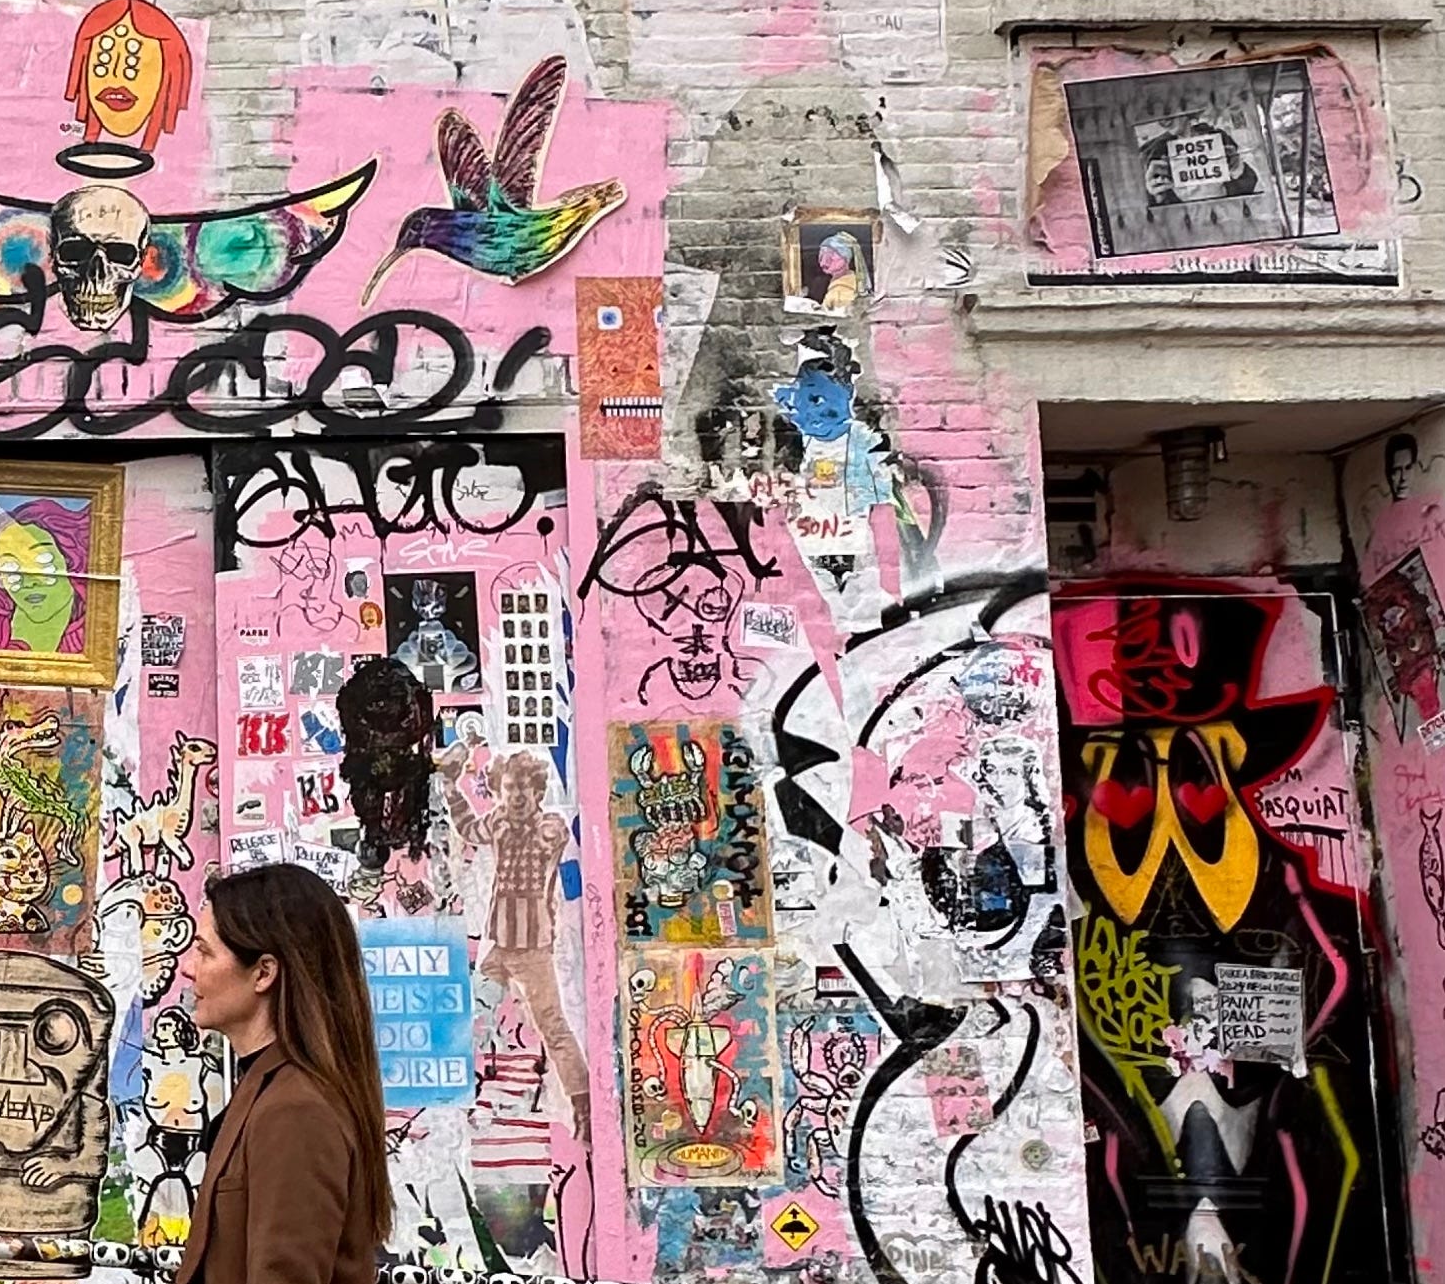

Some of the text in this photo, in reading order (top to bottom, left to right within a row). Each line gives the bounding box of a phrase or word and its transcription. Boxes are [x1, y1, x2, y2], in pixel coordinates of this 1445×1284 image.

[1176, 139, 1214, 155] POST
[1187, 154, 1209, 166] NO
[1179, 166, 1222, 182] BILLS
[363, 949, 444, 975] SAY
[380, 986, 459, 1011] ESS
[1221, 996, 1264, 1009] PAINT
[1221, 1009, 1267, 1023] DANCE
[377, 1024, 429, 1048] DO
[1222, 1025, 1267, 1040] READ
[385, 1060, 464, 1084] ORE
